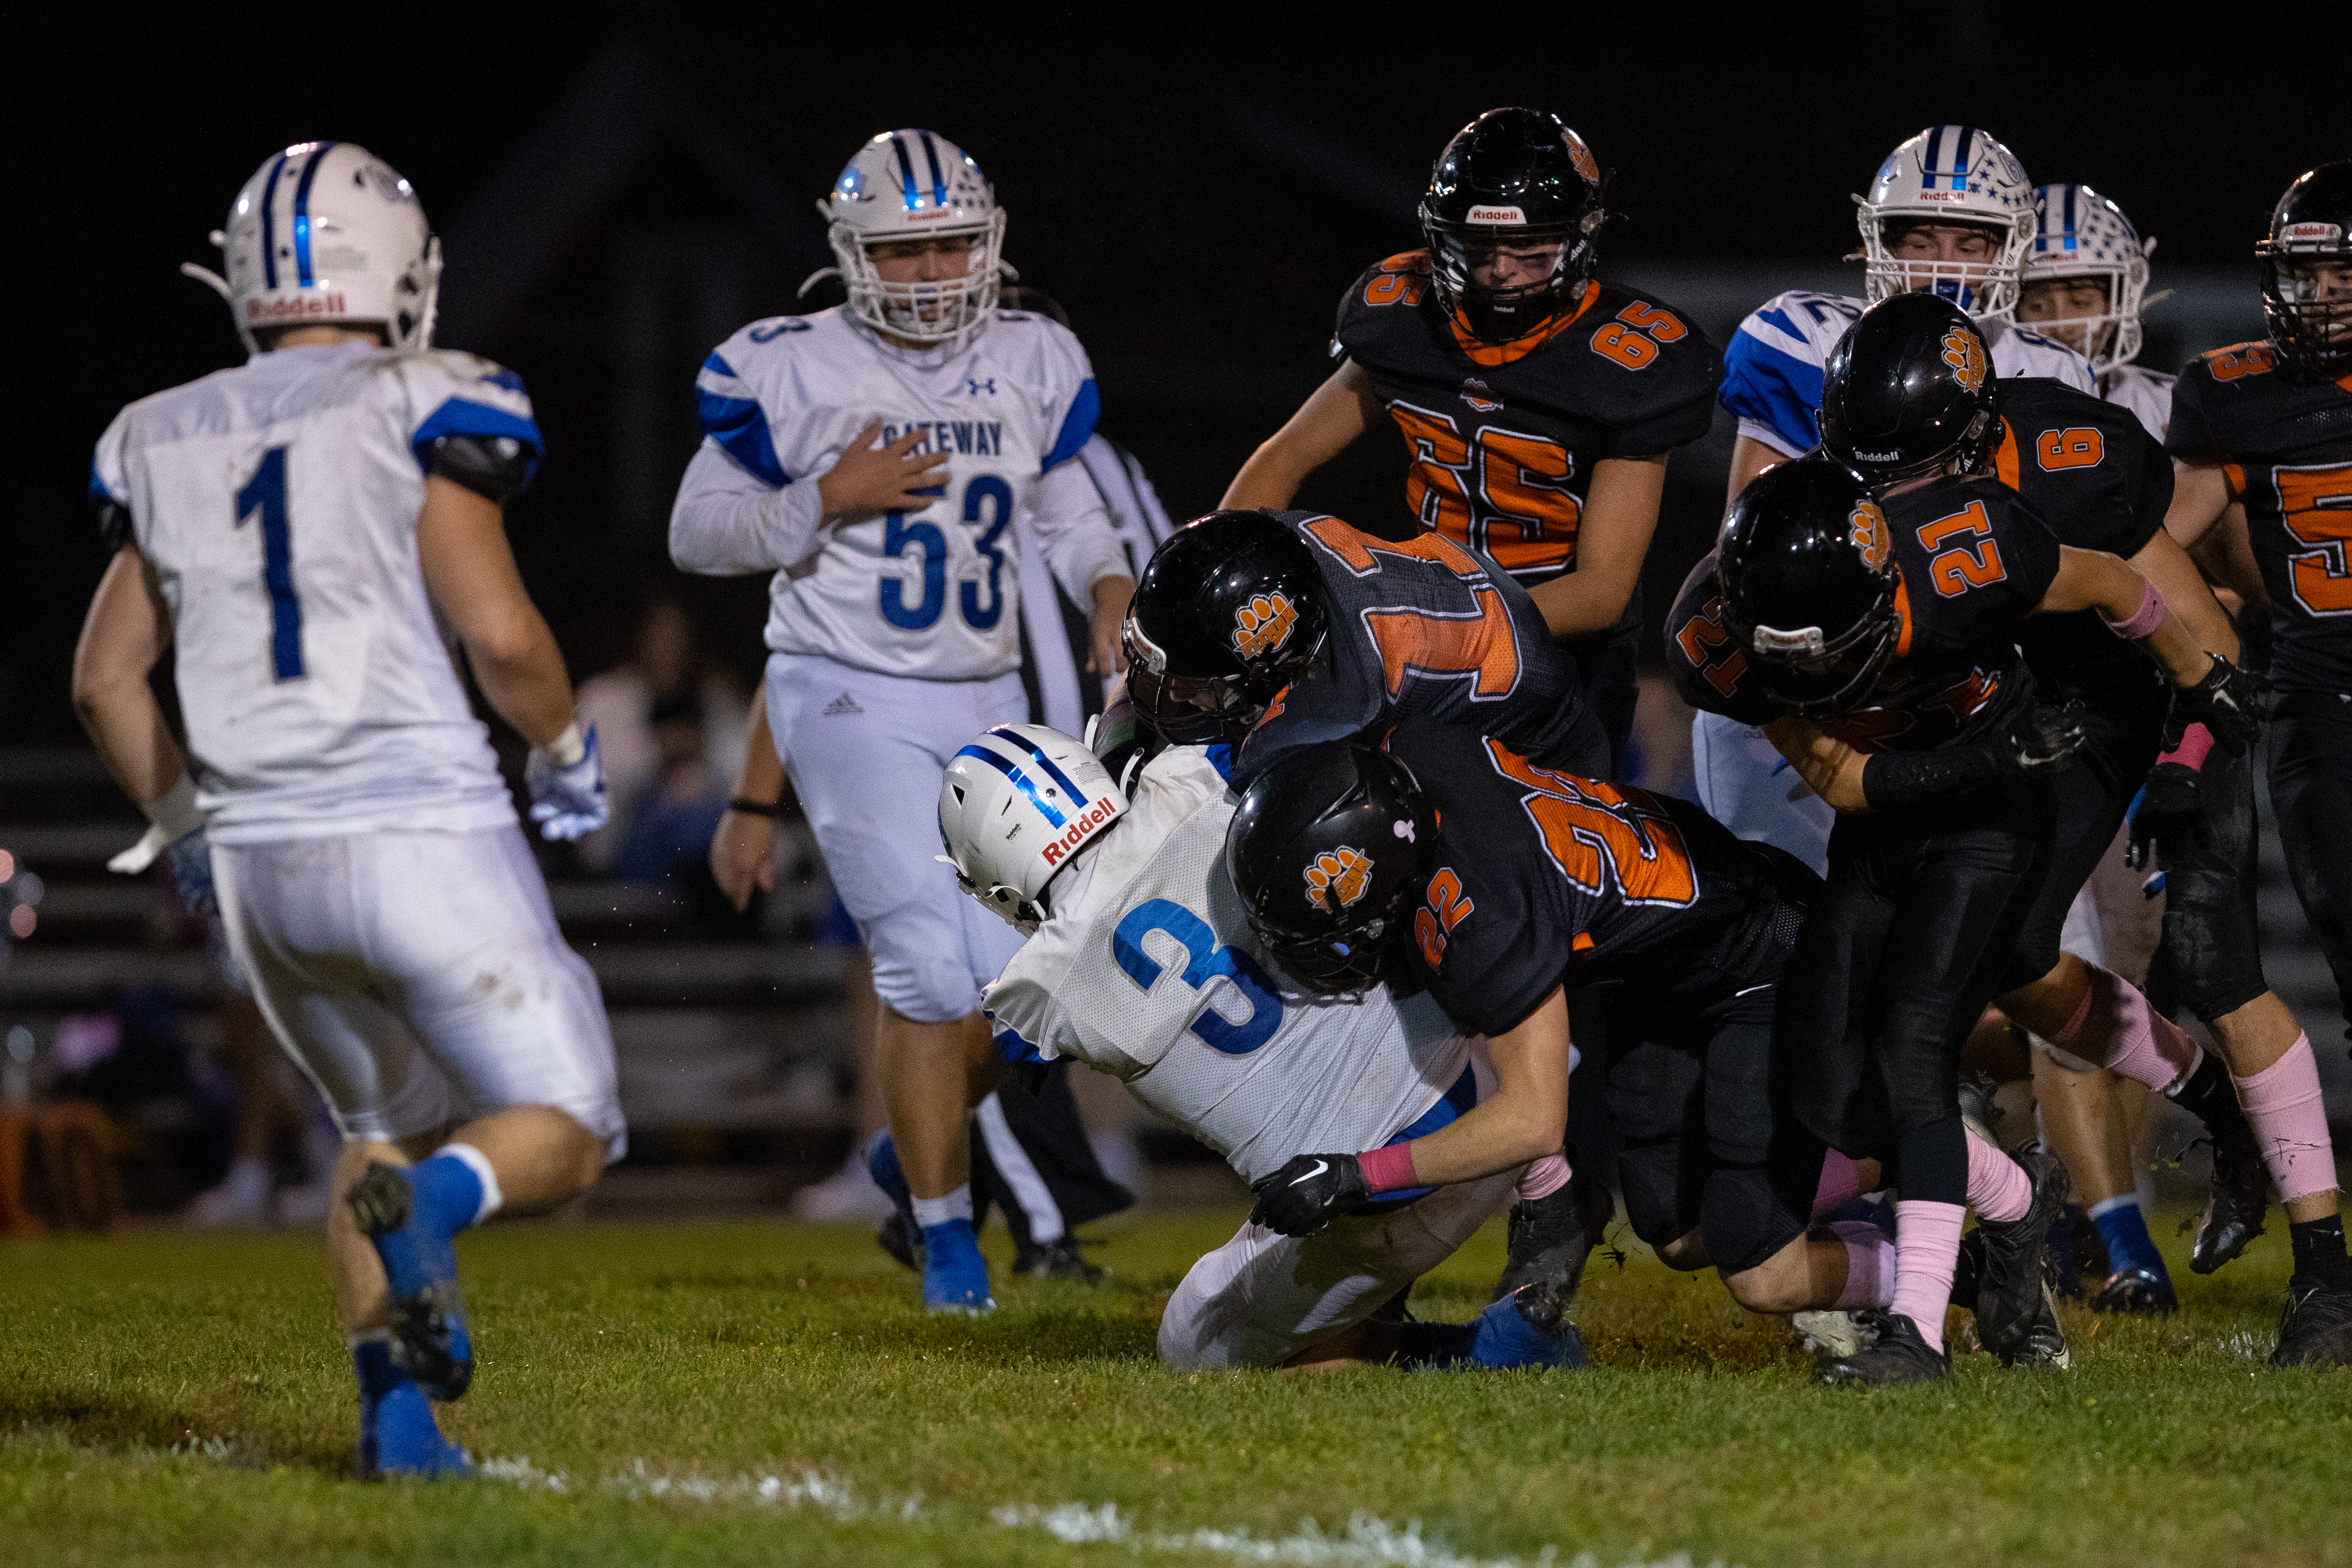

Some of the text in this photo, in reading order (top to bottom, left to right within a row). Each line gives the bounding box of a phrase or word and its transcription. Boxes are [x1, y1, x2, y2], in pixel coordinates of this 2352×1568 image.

[1473, 210, 1518, 220] Riddell
[2294, 226, 2325, 236] Riddell
[247, 291, 346, 320] Riddell
[1590, 299, 1688, 371] 65
[1387, 399, 1583, 575] 65
[1854, 451, 1899, 462] Riddell
[235, 445, 304, 681] 1
[881, 473, 1012, 630] 53
[1916, 499, 2008, 598] 21
[1042, 796, 1117, 867] Riddell
[1414, 866, 1474, 976] 22
[1112, 898, 1285, 1059] 3
